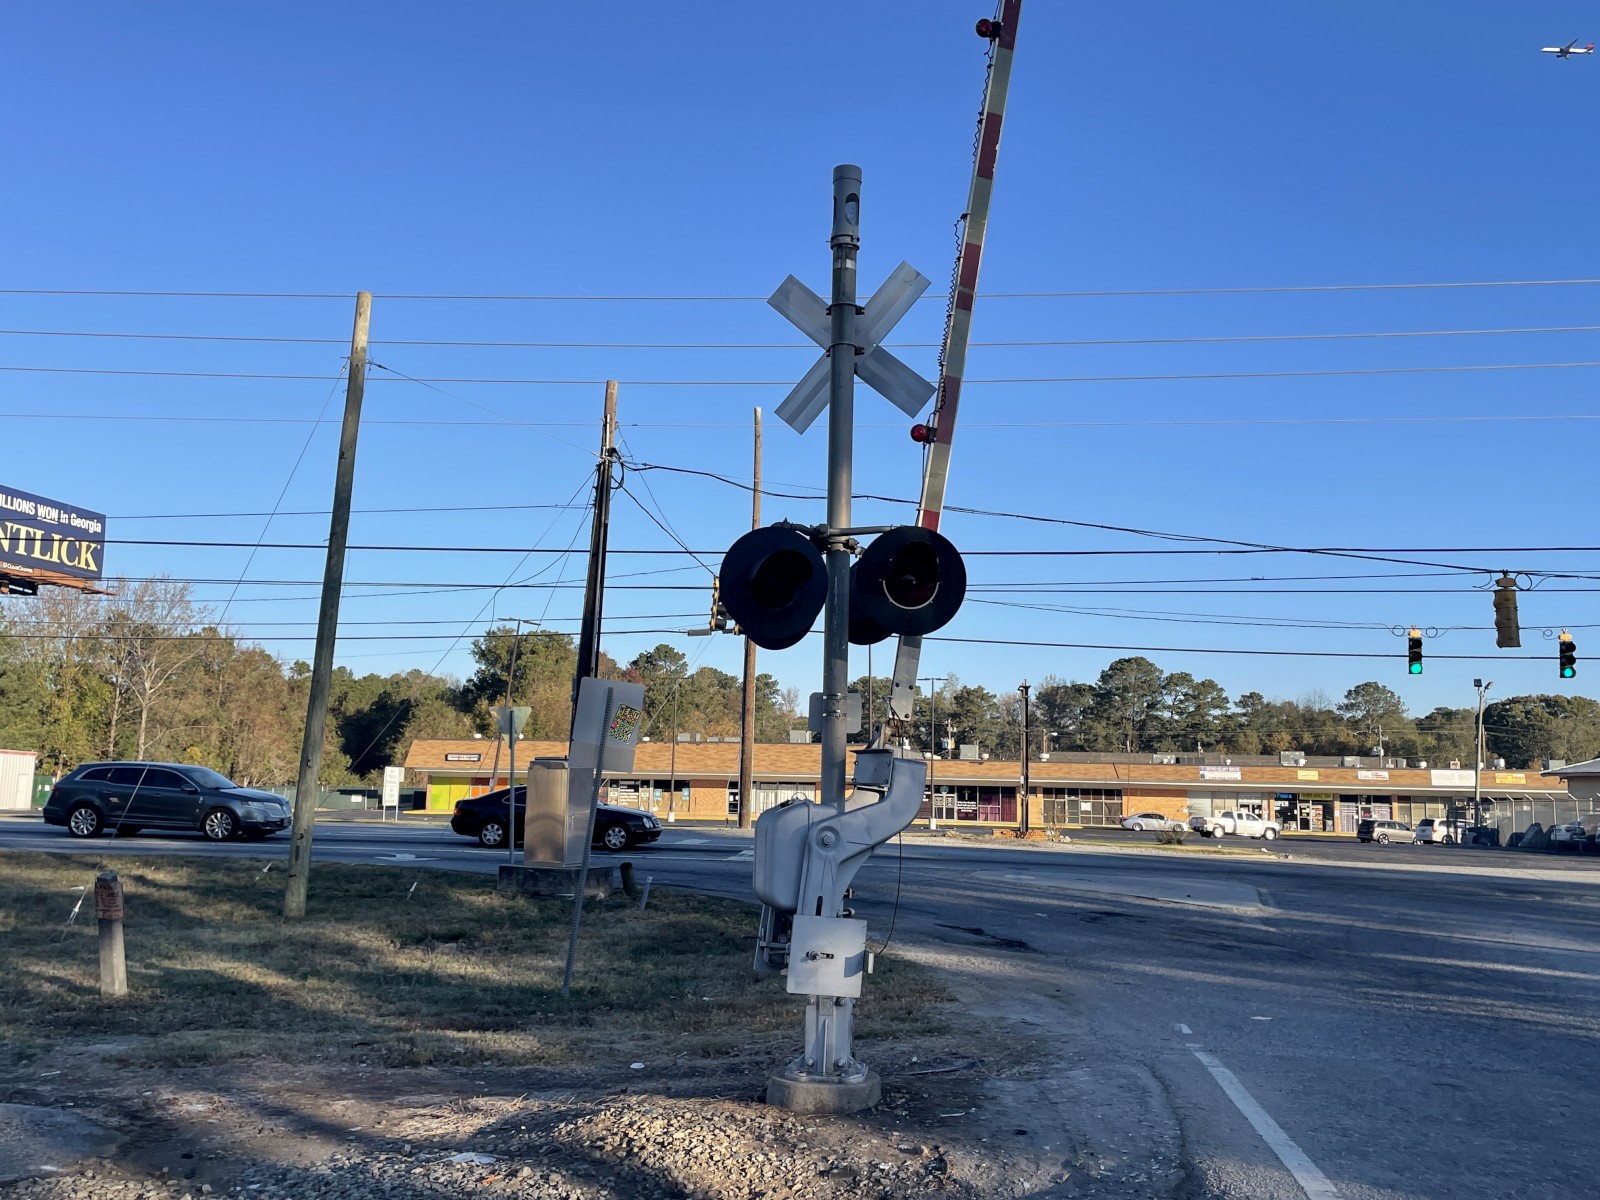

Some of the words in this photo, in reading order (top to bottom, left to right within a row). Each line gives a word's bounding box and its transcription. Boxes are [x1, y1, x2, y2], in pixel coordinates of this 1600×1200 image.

[37, 504, 58, 522] WON
[60, 510, 69, 524] in
[70, 513, 102, 534] Georgia
